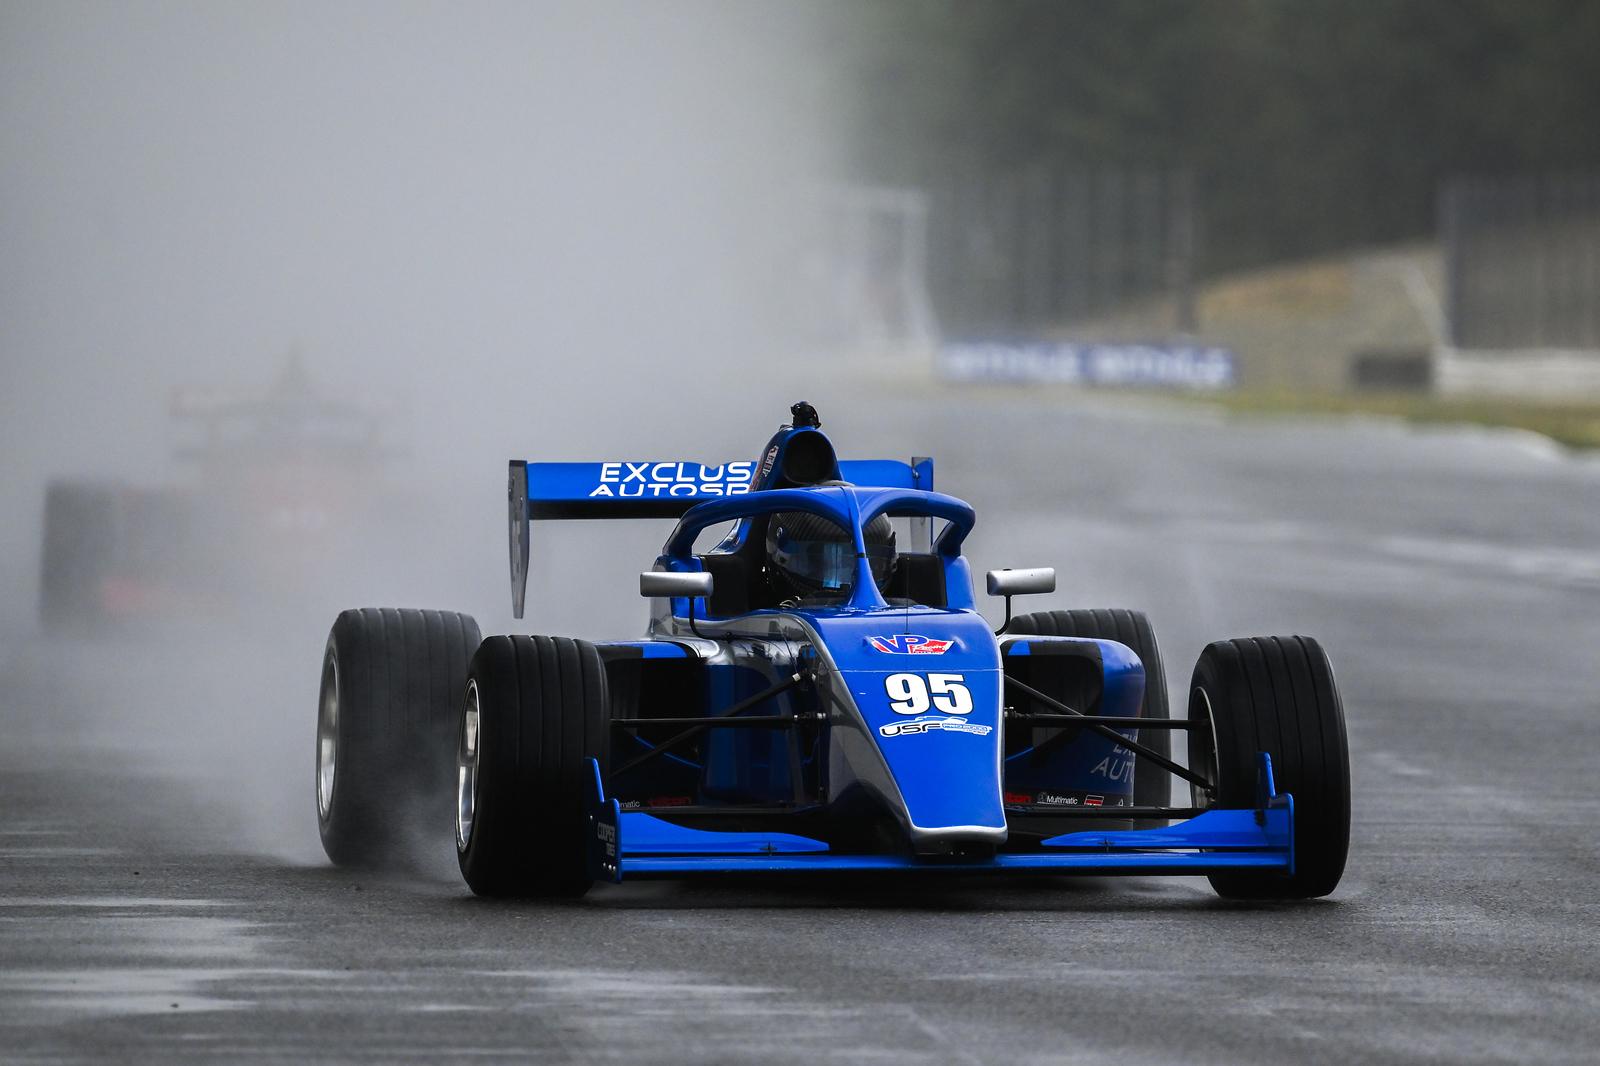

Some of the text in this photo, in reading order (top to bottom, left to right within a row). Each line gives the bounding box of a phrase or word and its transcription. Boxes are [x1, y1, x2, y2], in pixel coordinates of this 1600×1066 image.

[600, 461, 753, 482] EXCLUS
[871, 635, 930, 654] VP
[884, 673, 974, 715] 95
[881, 723, 942, 736] USF
[1046, 795, 1078, 805] Multimatic
